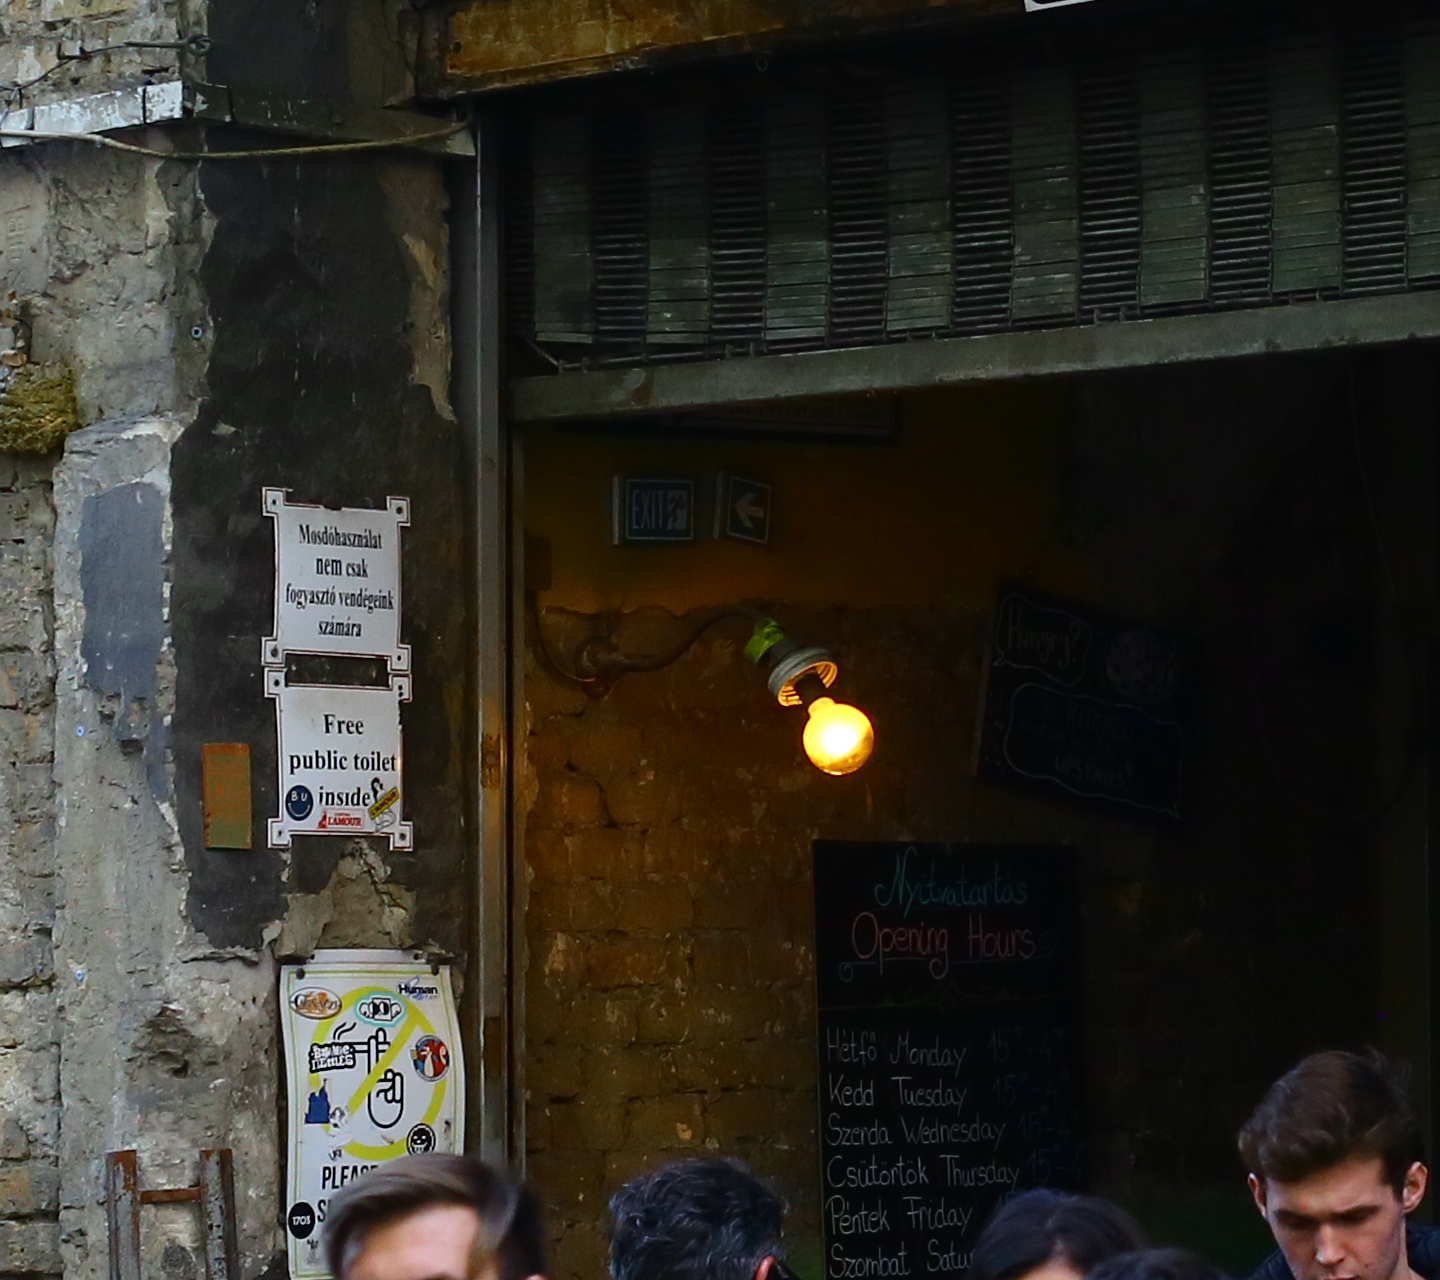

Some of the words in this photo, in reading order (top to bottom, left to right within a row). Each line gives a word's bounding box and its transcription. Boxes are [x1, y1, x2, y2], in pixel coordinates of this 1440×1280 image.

[632, 490, 664, 529] EXIT
[299, 524, 382, 549] Mosdóhasználat
[316, 557, 342, 576] nem
[346, 561, 368, 578] csak
[286, 585, 336, 610] fogyasztó
[339, 589, 394, 613] vendégeink
[318, 616, 362, 638] számára
[324, 714, 364, 735] Free
[290, 750, 347, 774] public
[354, 753, 396, 772] toilet
[319, 785, 370, 807] inside
[851, 912, 950, 979] Opening
[968, 914, 1035, 959] Hours
[399, 984, 438, 995] Human
[890, 1033, 968, 1078] Monday
[829, 1074, 874, 1107] Kedd
[892, 1077, 968, 1117] Tuesday
[826, 1114, 892, 1148] Szerda
[901, 1115, 1006, 1150] Wednesday
[827, 1155, 929, 1188] Csütörtök
[939, 1155, 1020, 1189] Thursday
[826, 1195, 890, 1235] Péntek
[903, 1197, 974, 1233] Friday
[830, 1244, 911, 1279] Szombat
[927, 1240, 974, 1271] Satu
